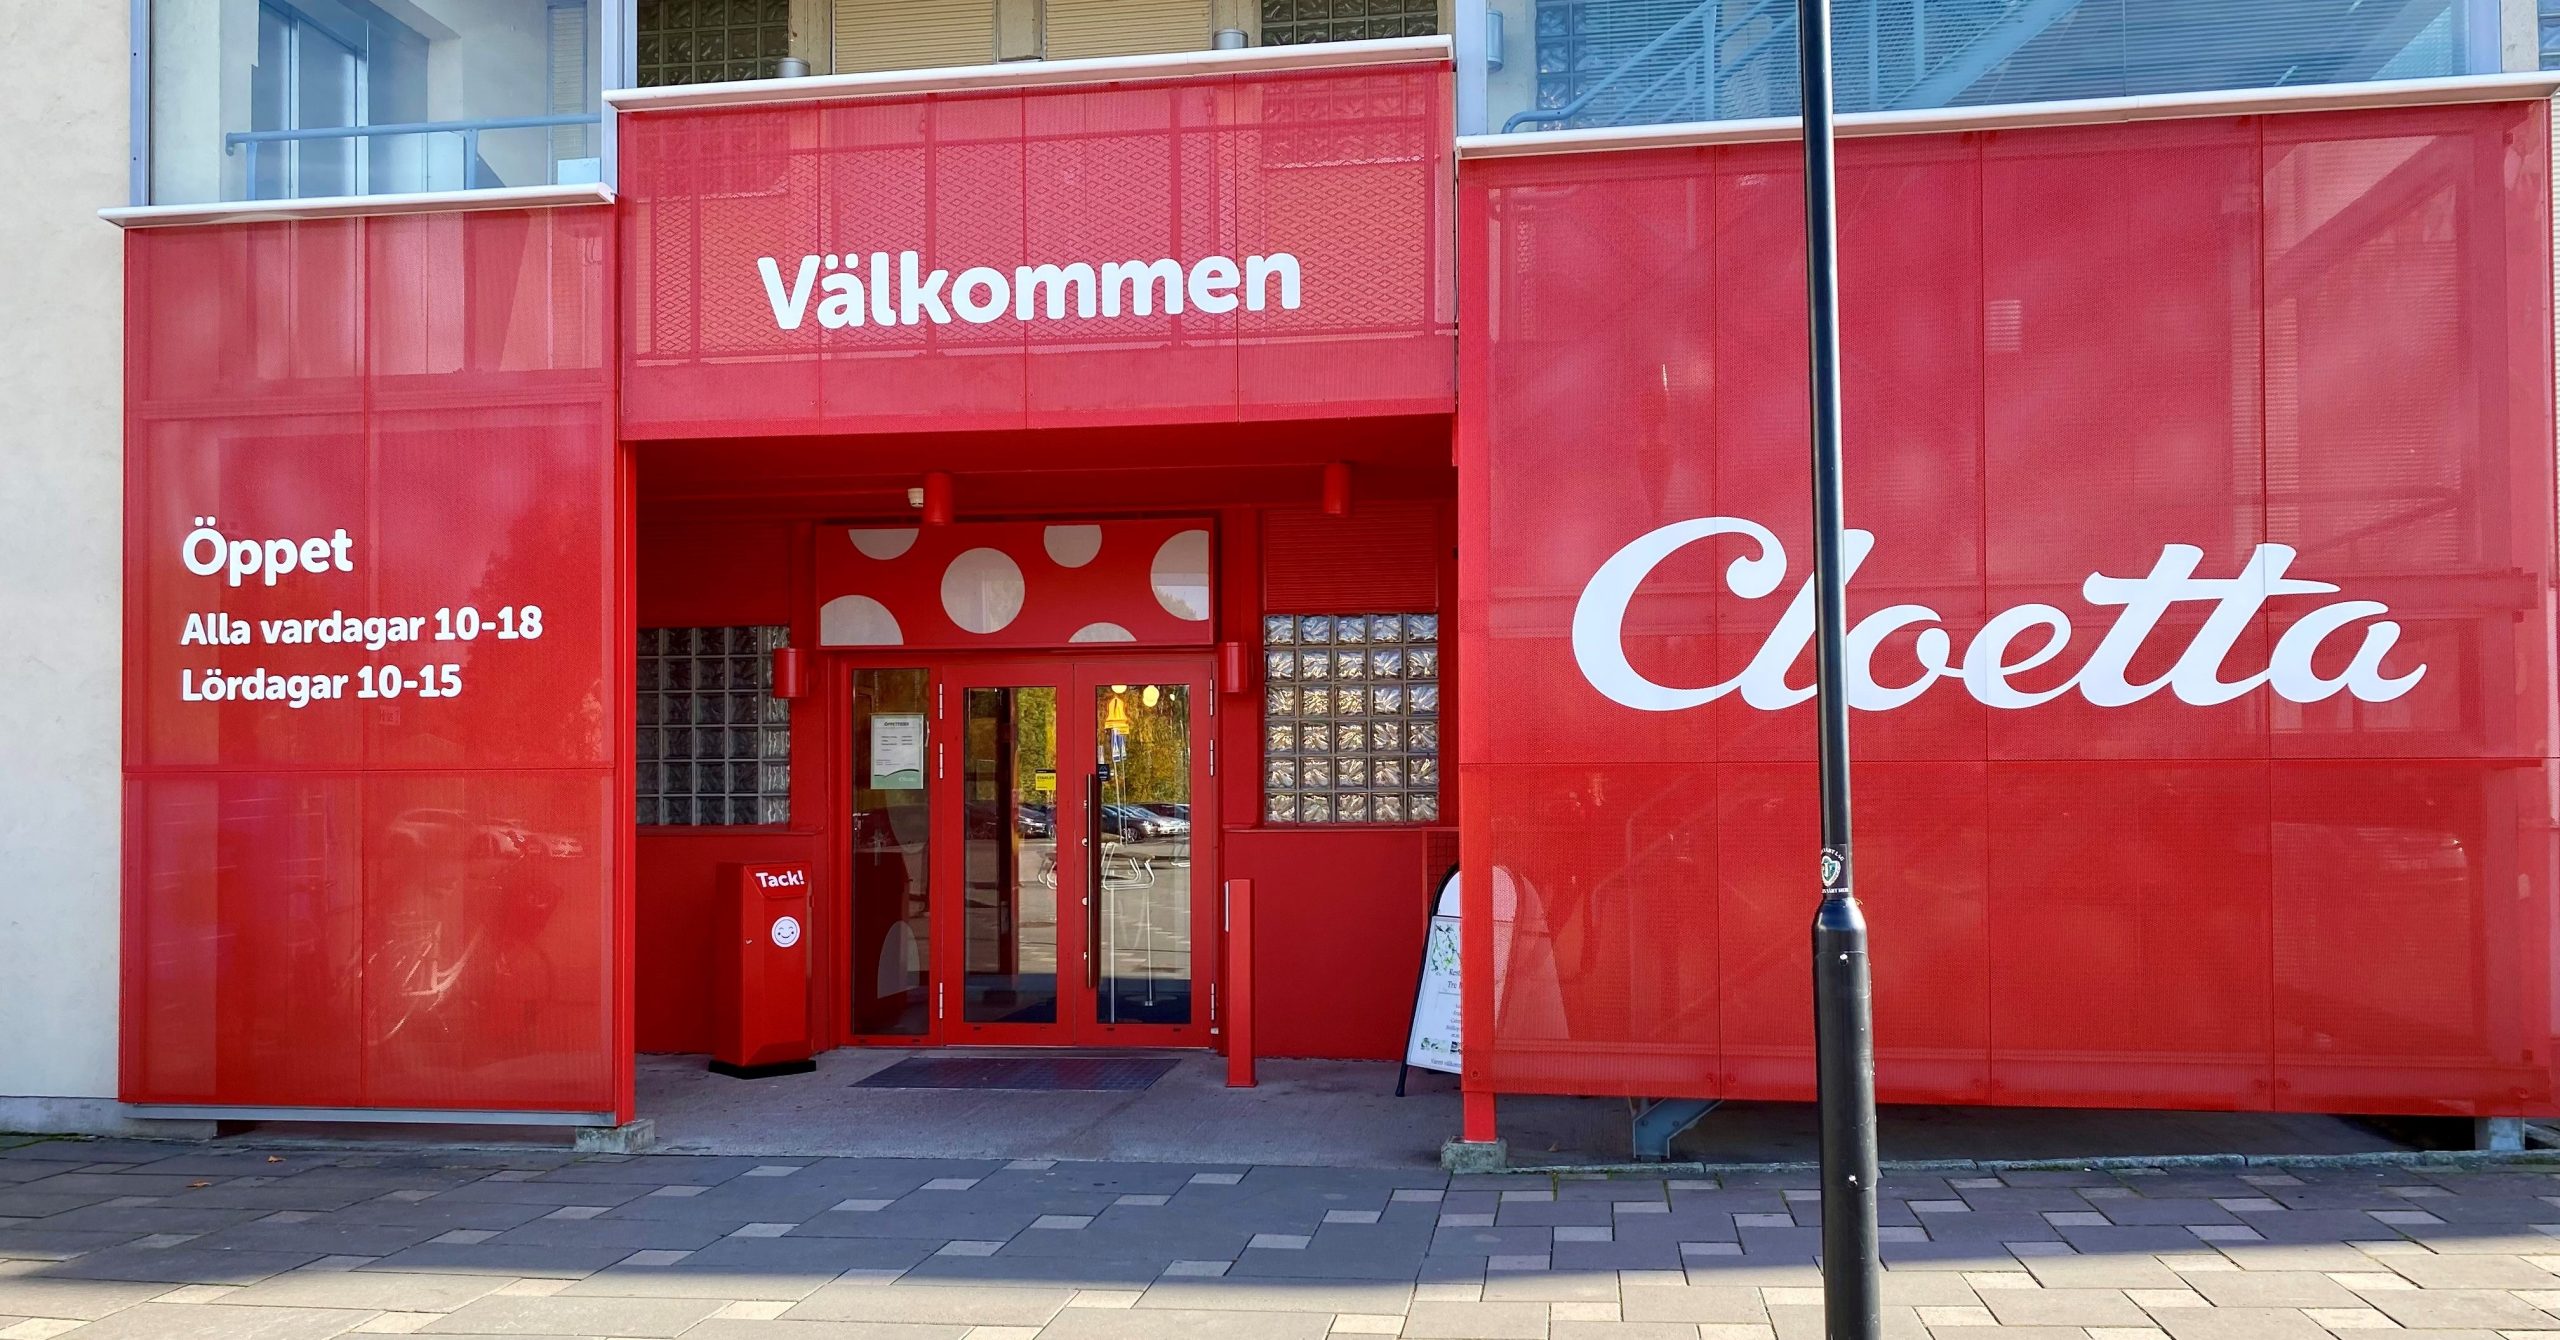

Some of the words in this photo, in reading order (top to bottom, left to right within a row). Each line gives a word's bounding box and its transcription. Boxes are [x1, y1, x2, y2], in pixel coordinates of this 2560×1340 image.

[756, 250, 1302, 331] Välkommen
[182, 516, 354, 587] Öppet
[180, 612, 251, 646] Alla
[260, 609, 426, 651] vardagar
[434, 604, 543, 641] 10-18
[1571, 516, 2427, 712] Cloetta
[182, 667, 349, 709] Lördagar
[357, 663, 463, 699] 10-15
[755, 870, 805, 888] Tack!
